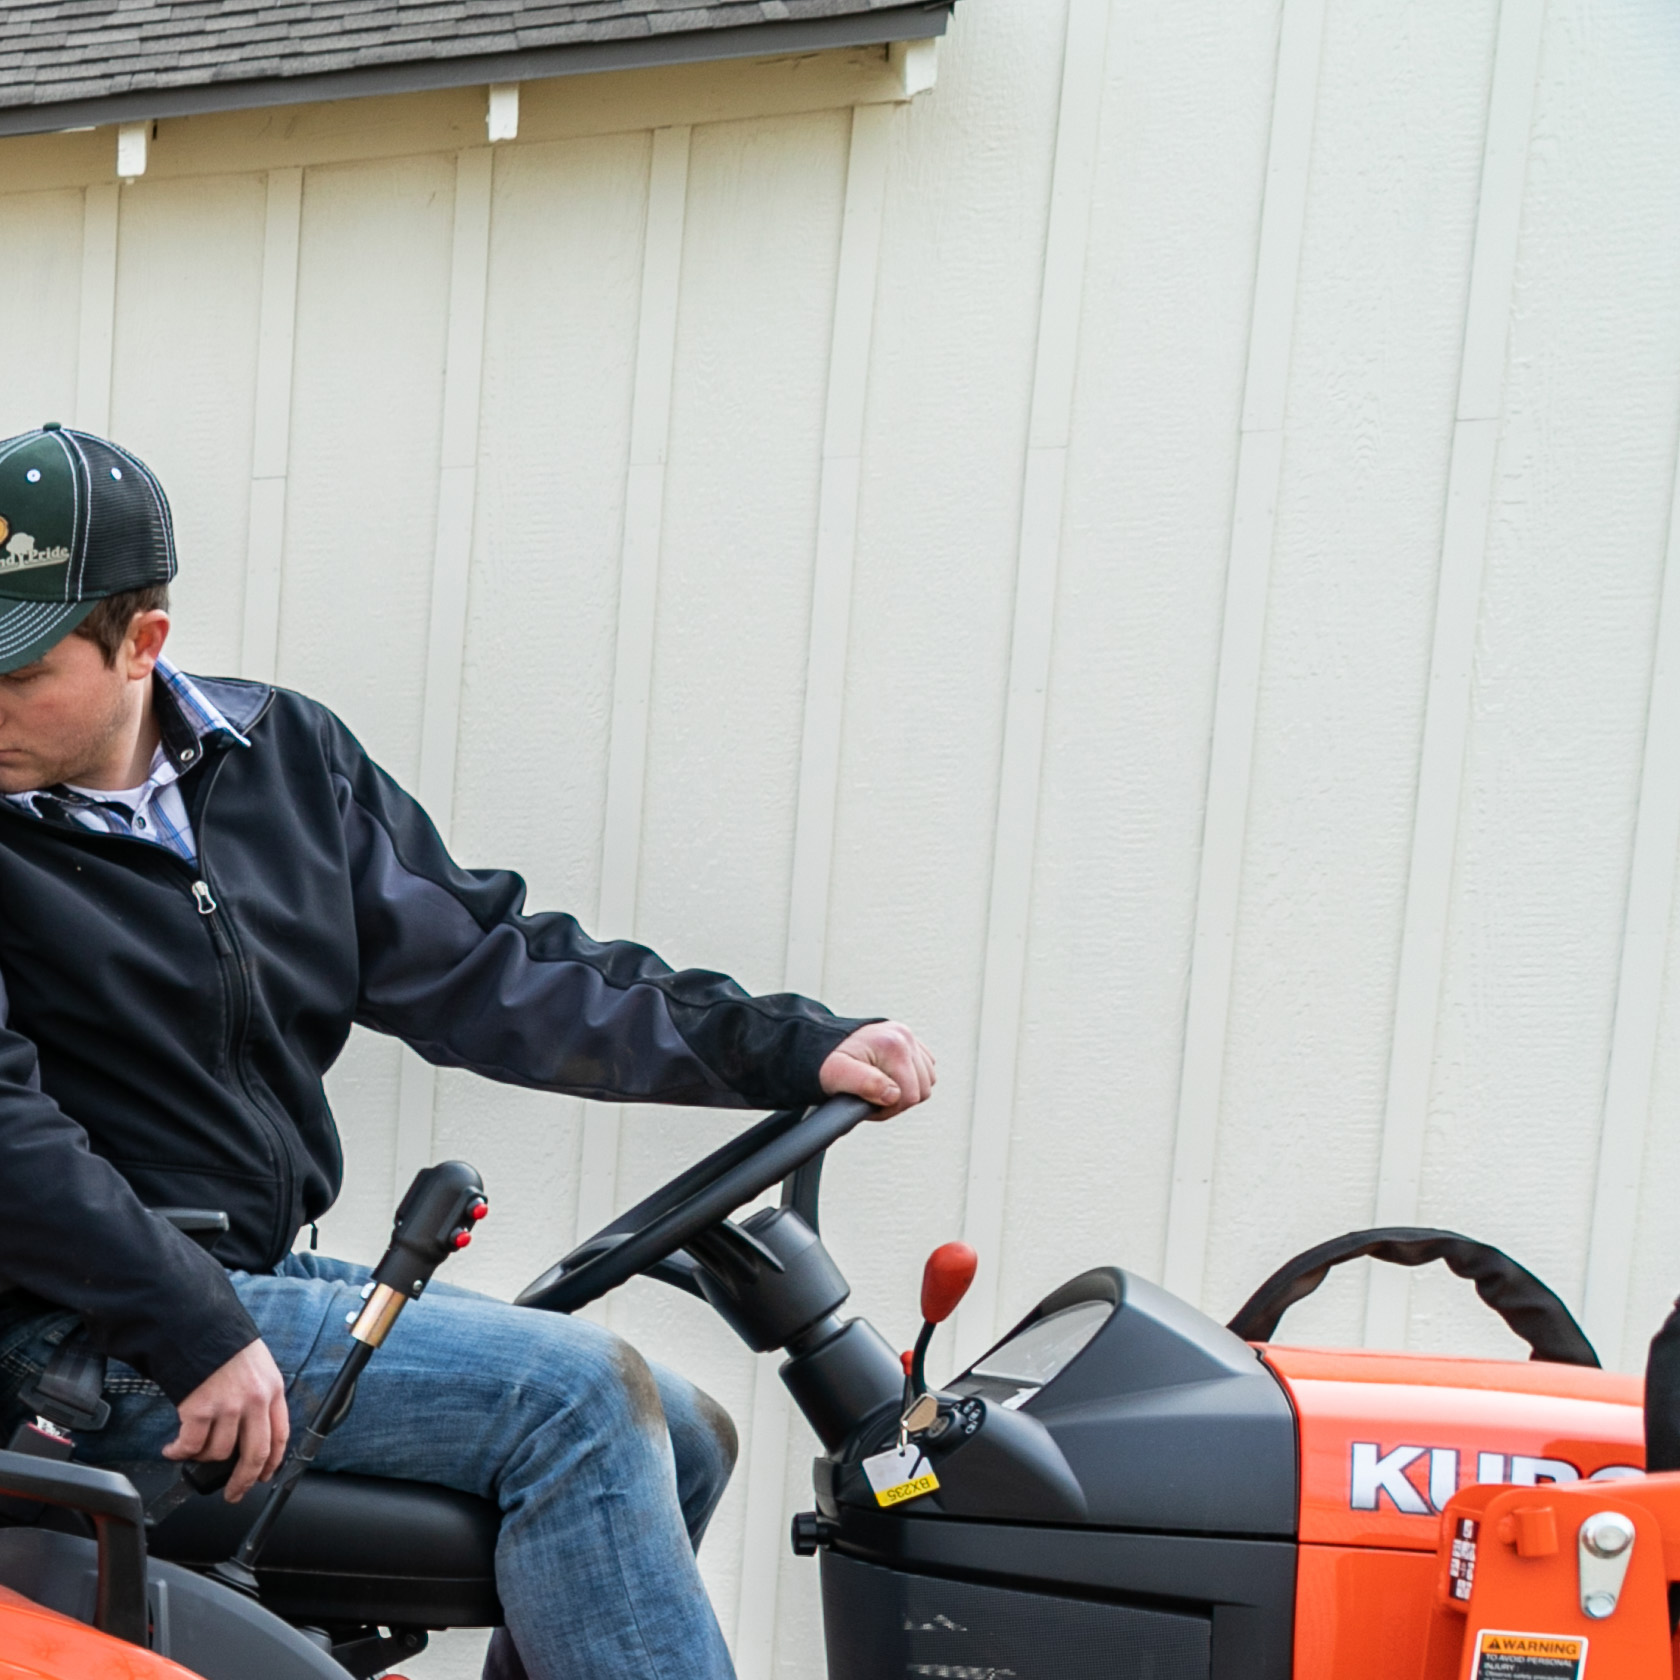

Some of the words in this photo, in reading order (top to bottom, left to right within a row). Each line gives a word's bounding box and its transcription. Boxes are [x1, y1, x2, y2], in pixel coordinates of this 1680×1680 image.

[28, 545, 70, 563] Pride
[886, 1476, 931, 1501] BX235
[1503, 1639, 1576, 1654] WARNING
[1528, 1658, 1572, 1666] PERSONAL
